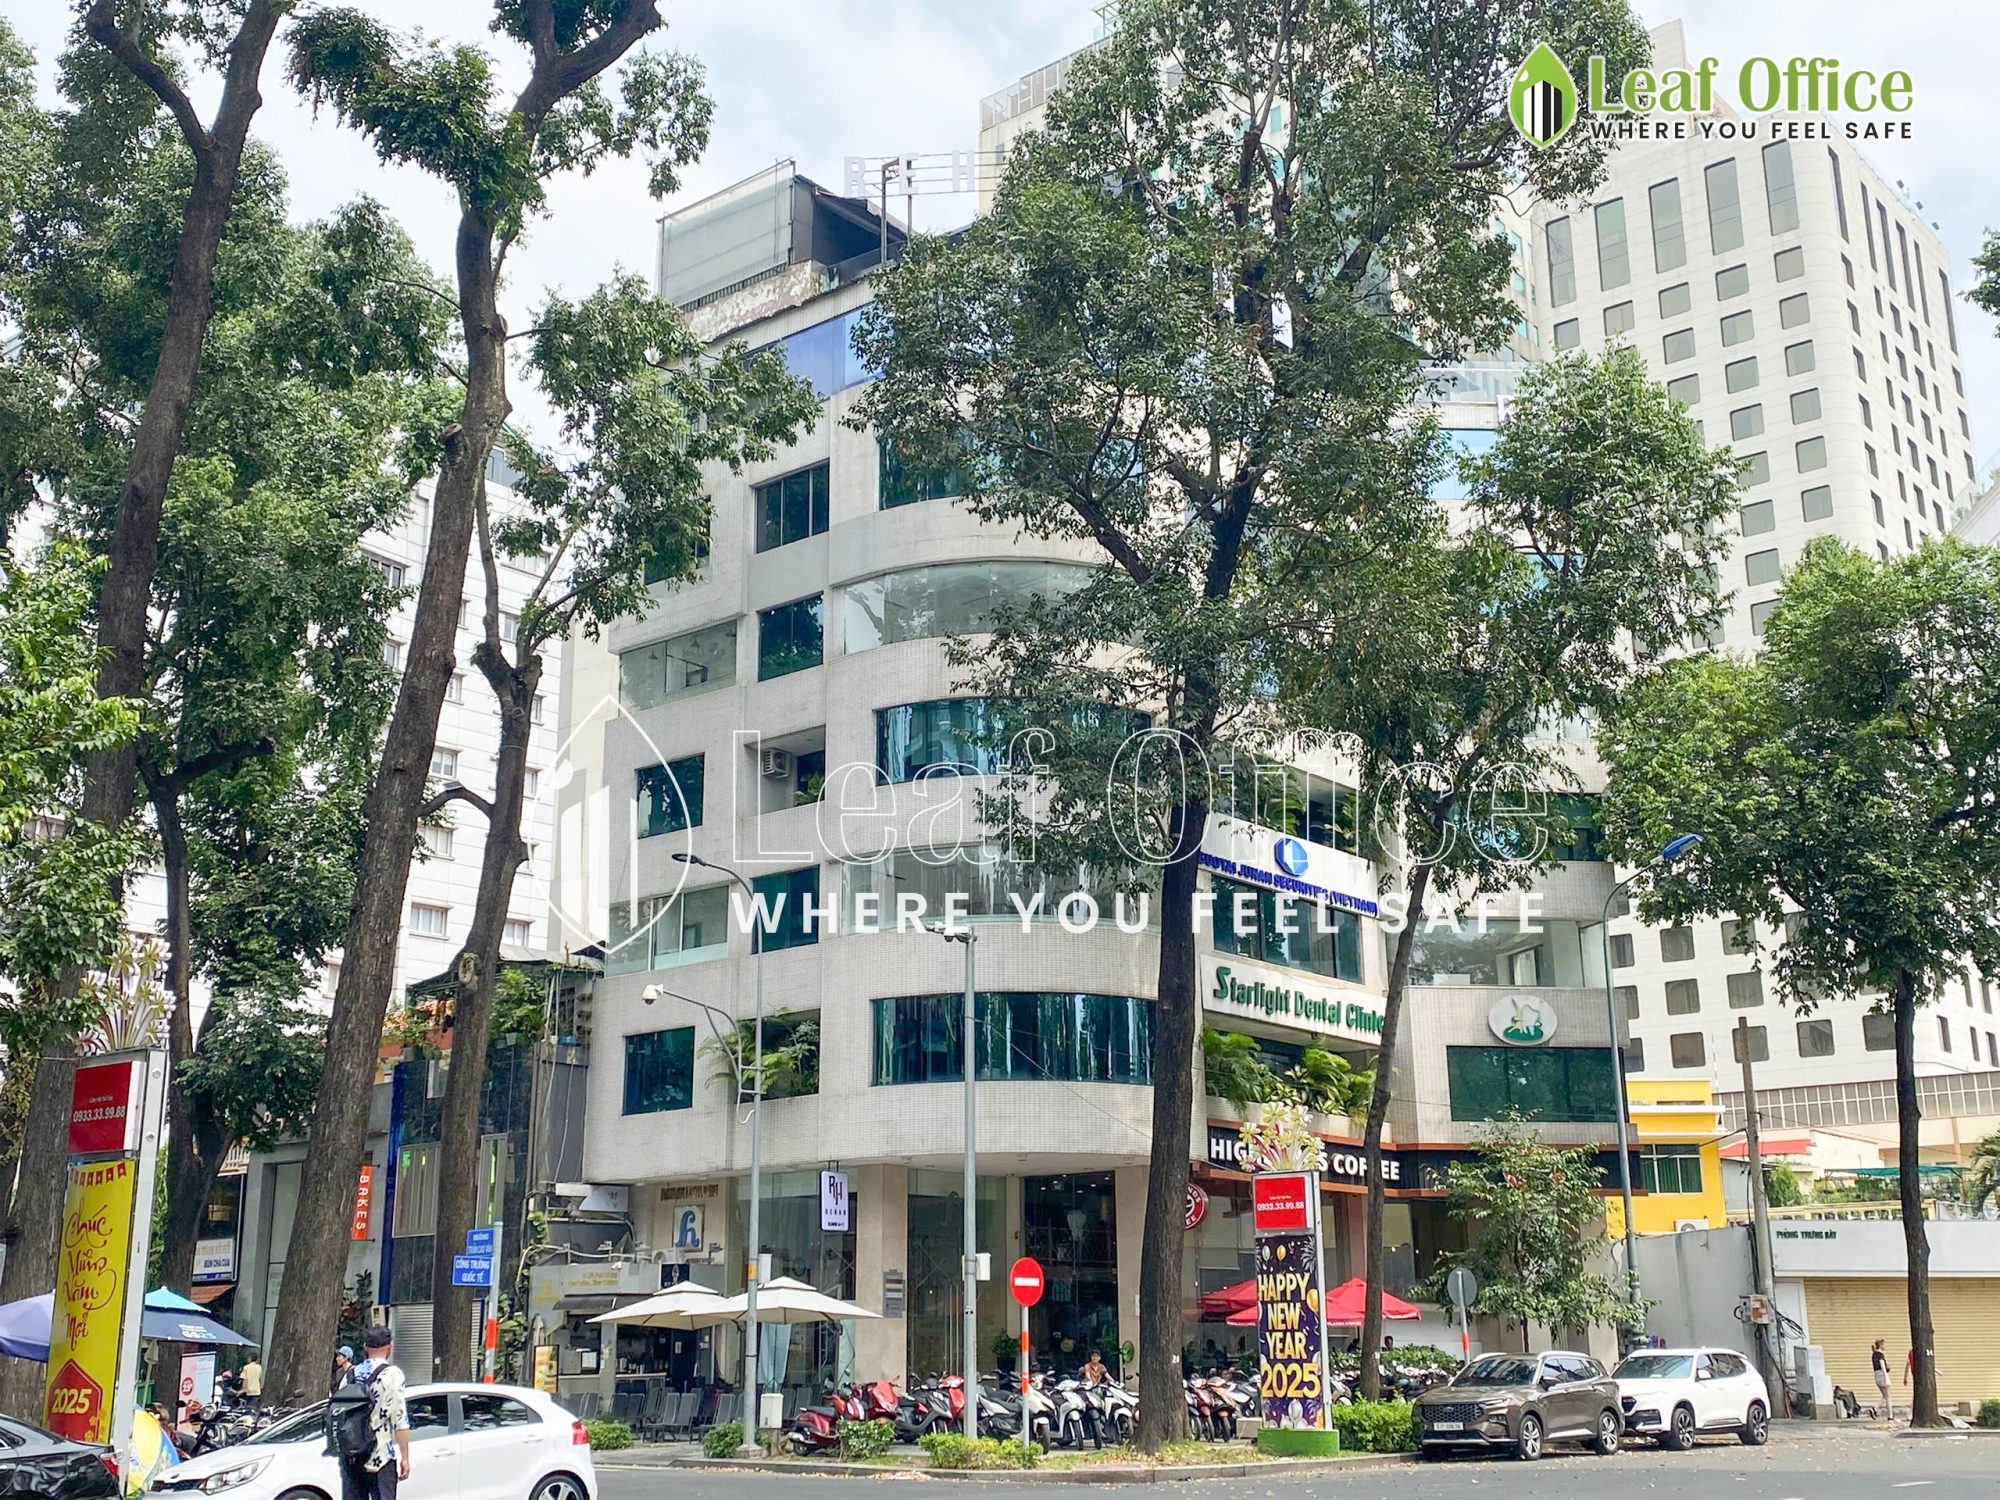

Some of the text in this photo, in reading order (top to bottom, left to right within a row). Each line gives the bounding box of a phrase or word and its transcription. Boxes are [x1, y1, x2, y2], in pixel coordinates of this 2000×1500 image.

[1238, 863, 1272, 886] JUNAN
[1273, 873, 1329, 902] SECURITIES
[1213, 965, 1386, 1035] Starlight Dental Clinic
[1332, 1152, 1401, 1181] COFEE
[355, 1174, 371, 1231] BAKES
[1776, 1228, 1799, 1239] PHÒNG
[1257, 1272, 1311, 1301] HAPPY
[1267, 1302, 1302, 1331] NEW
[1265, 1332, 1308, 1360] YEAR
[1261, 1362, 1321, 1398] 2025
[52, 1387, 92, 1414] 2025
